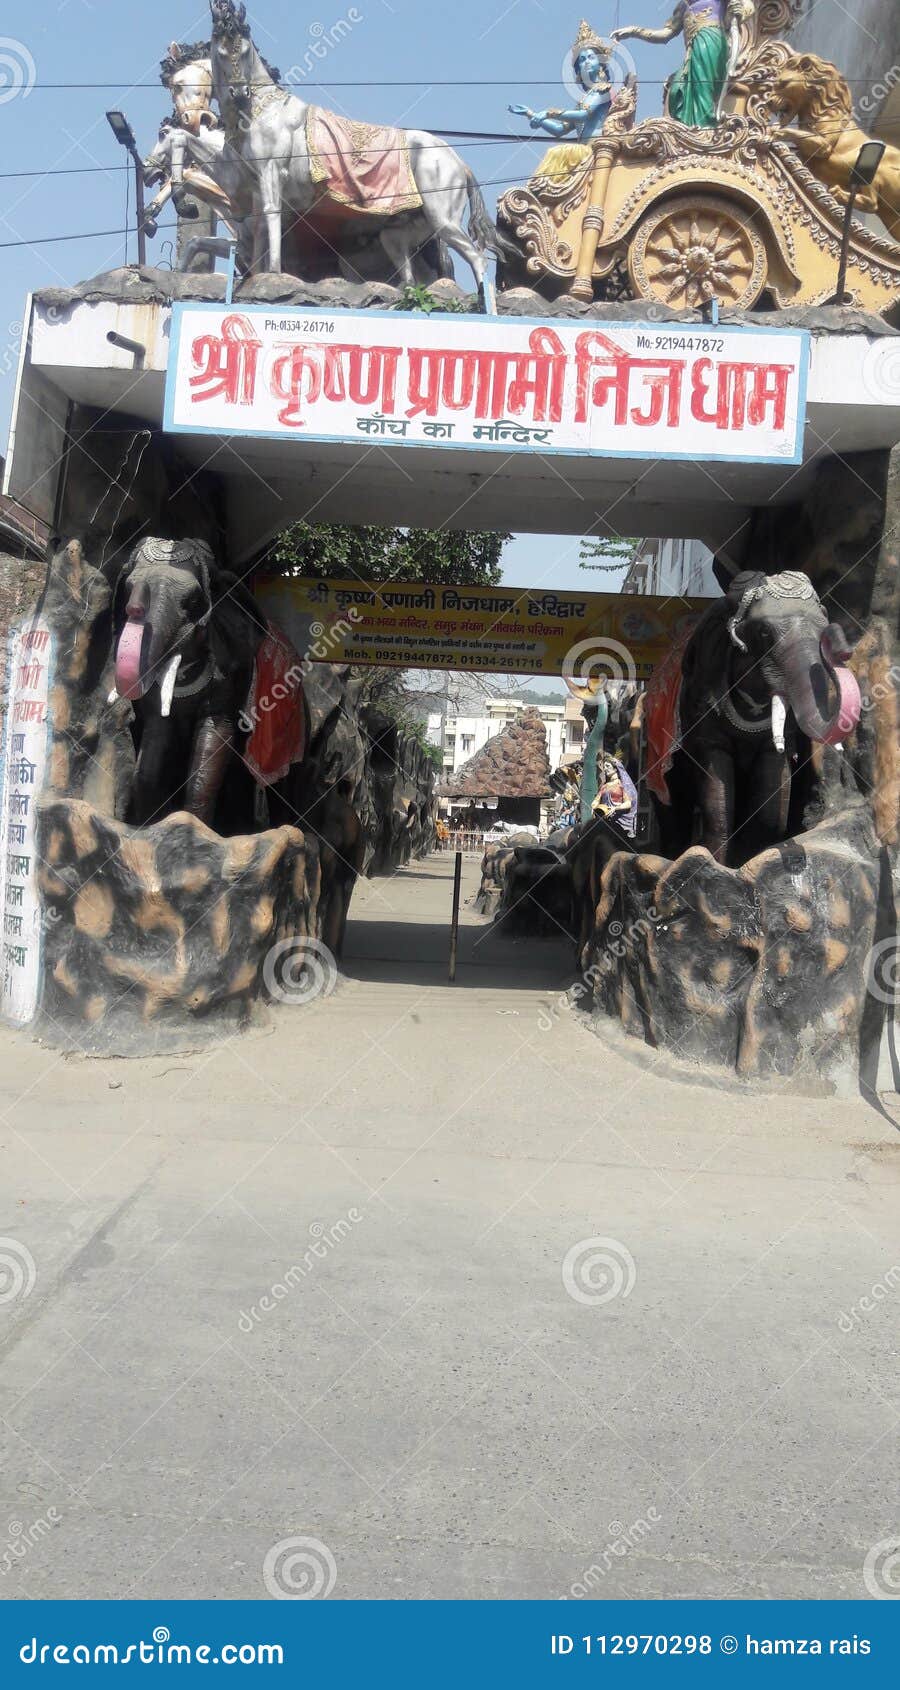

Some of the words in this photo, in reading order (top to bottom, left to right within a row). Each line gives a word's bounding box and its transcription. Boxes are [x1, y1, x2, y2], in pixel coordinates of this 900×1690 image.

[189, 313, 263, 405] श्री
[270, 340, 403, 427] कृष्ण
[405, 327, 567, 423] प्रणामी
[422, 420, 455, 439] का
[472, 419, 554, 445] मन्दिर
[306, 582, 329, 604] श्री
[335, 589, 376, 612] कृष्ण
[380, 588, 436, 611] प्रणामी
[527, 595, 588, 619] हरिद्वार
[344, 649, 371, 660] Mob.
